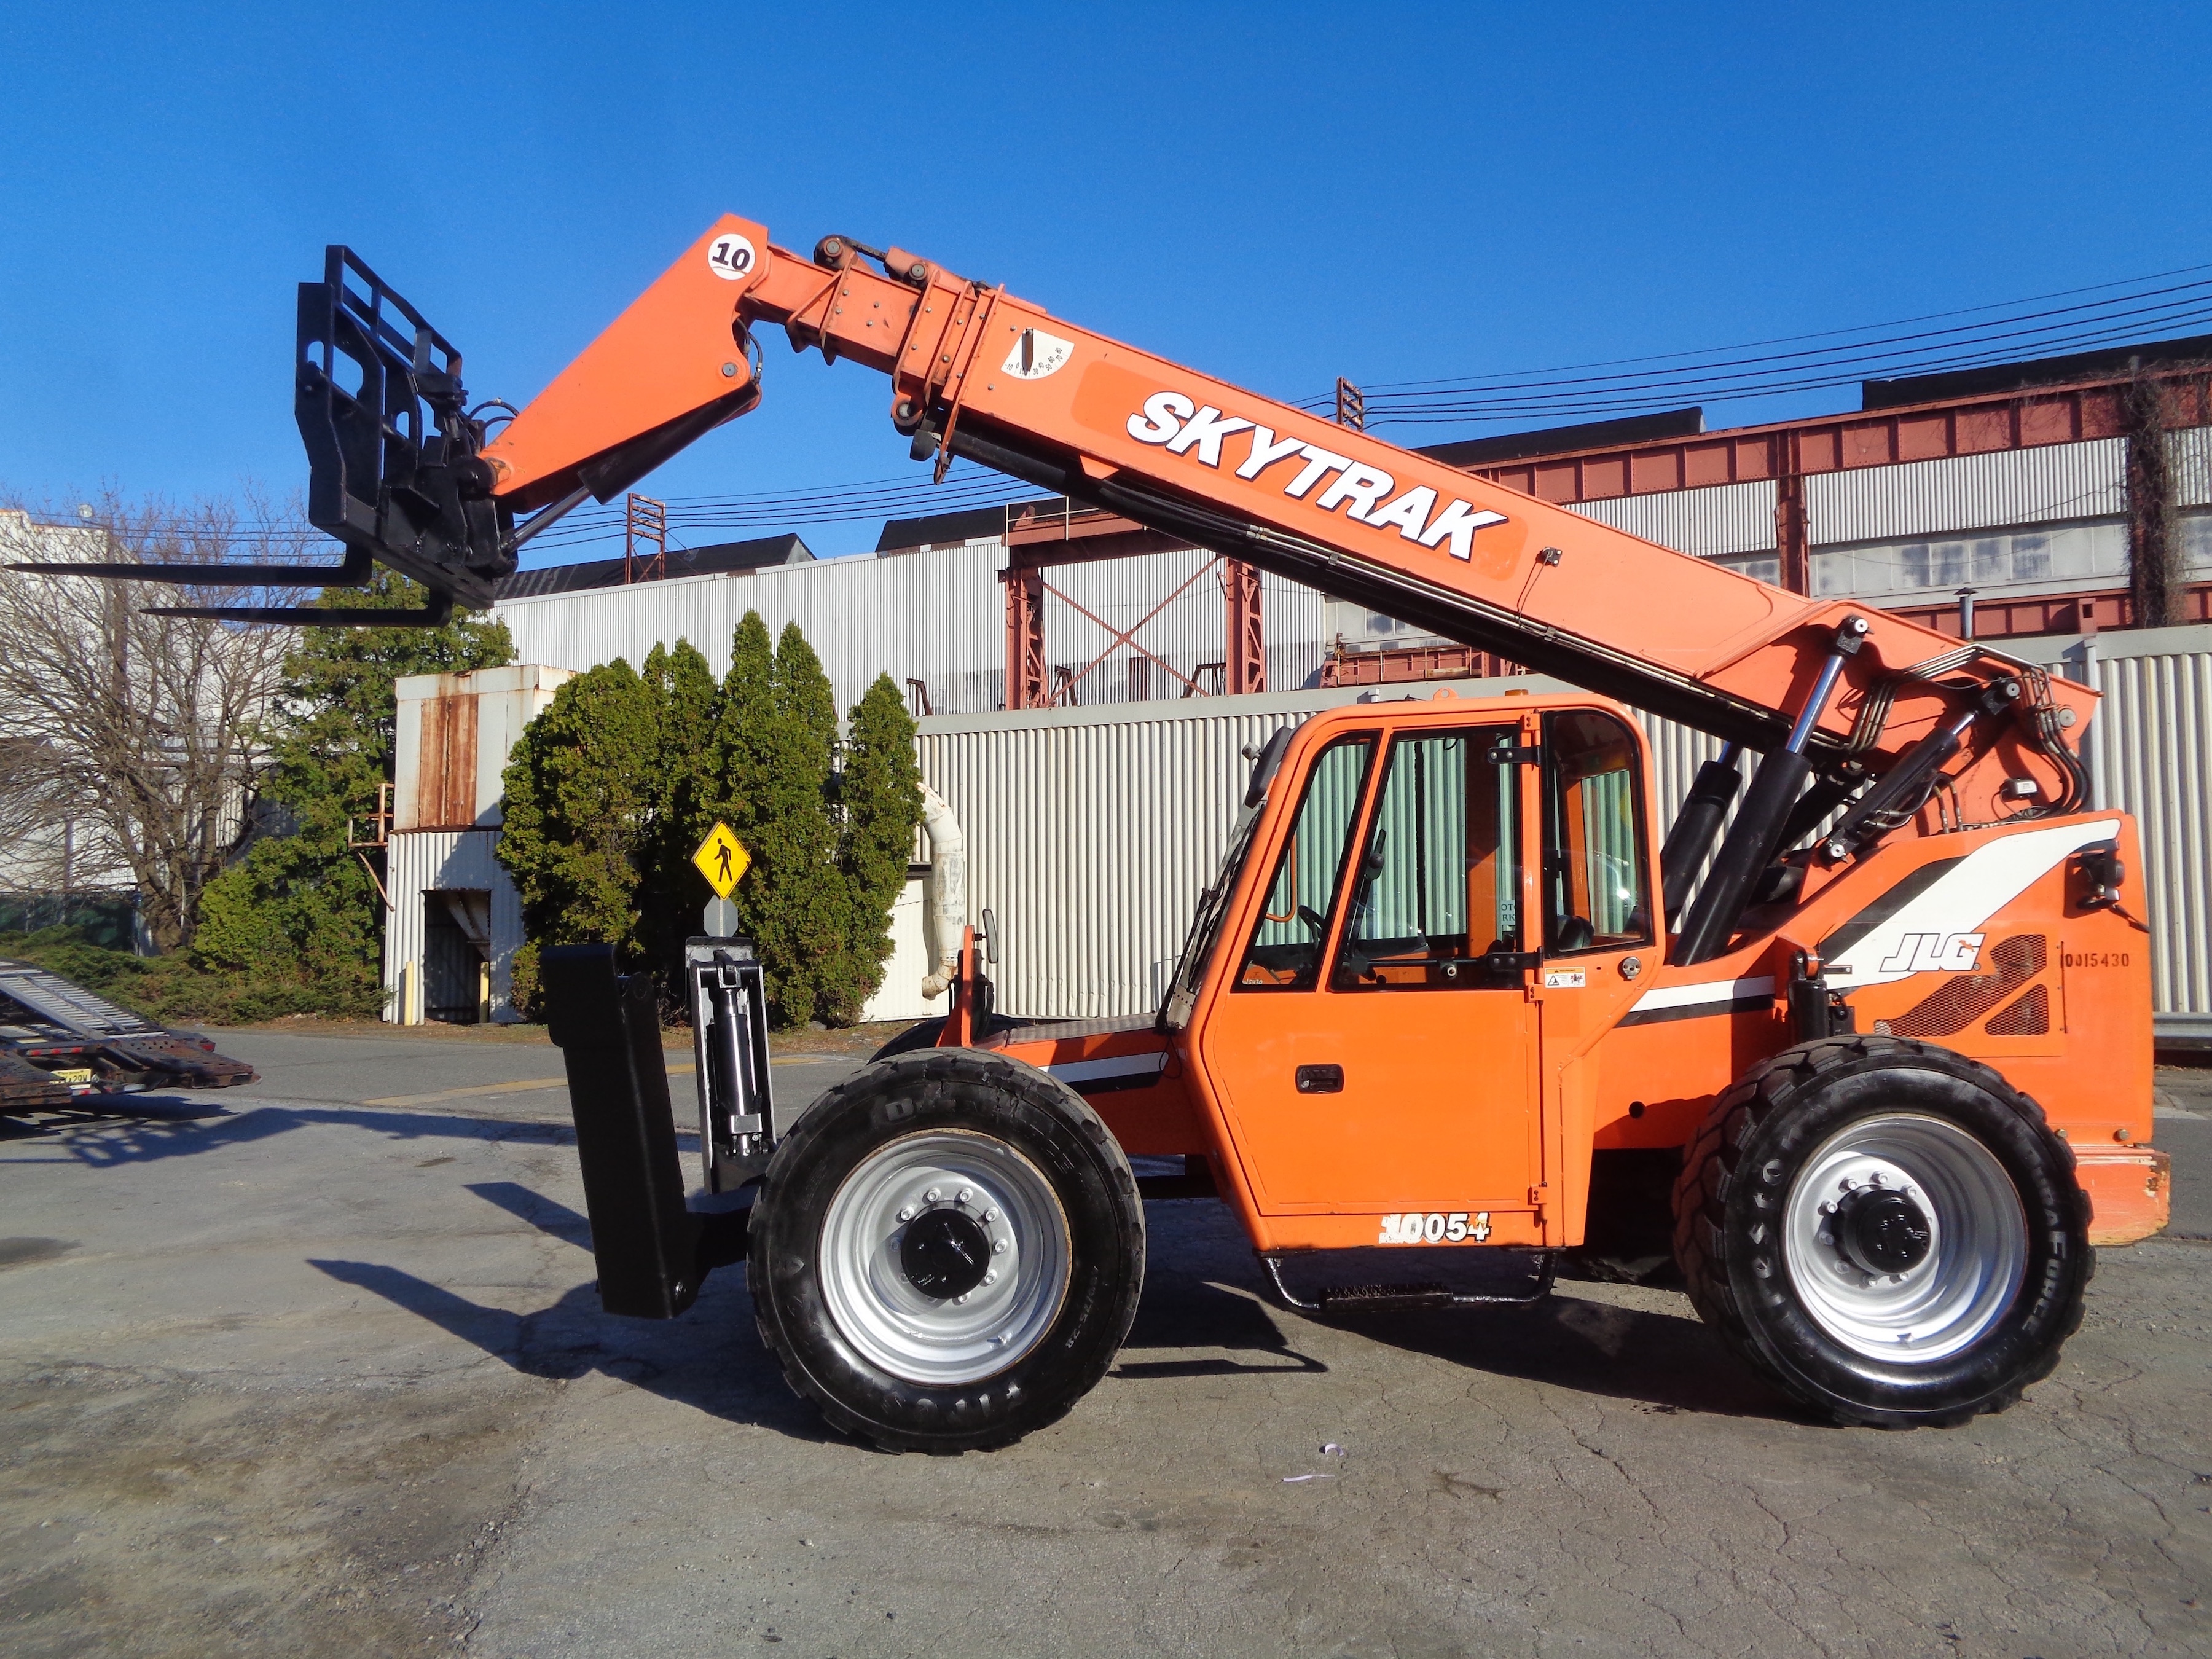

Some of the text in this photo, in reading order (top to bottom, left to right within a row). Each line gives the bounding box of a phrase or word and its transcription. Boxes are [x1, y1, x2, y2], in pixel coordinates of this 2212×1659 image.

[712, 243, 750, 270] 10
[1126, 391, 1509, 562] SKYTRAK
[1878, 933, 1986, 972] JLG
[1378, 1212, 1491, 1244] 10054
